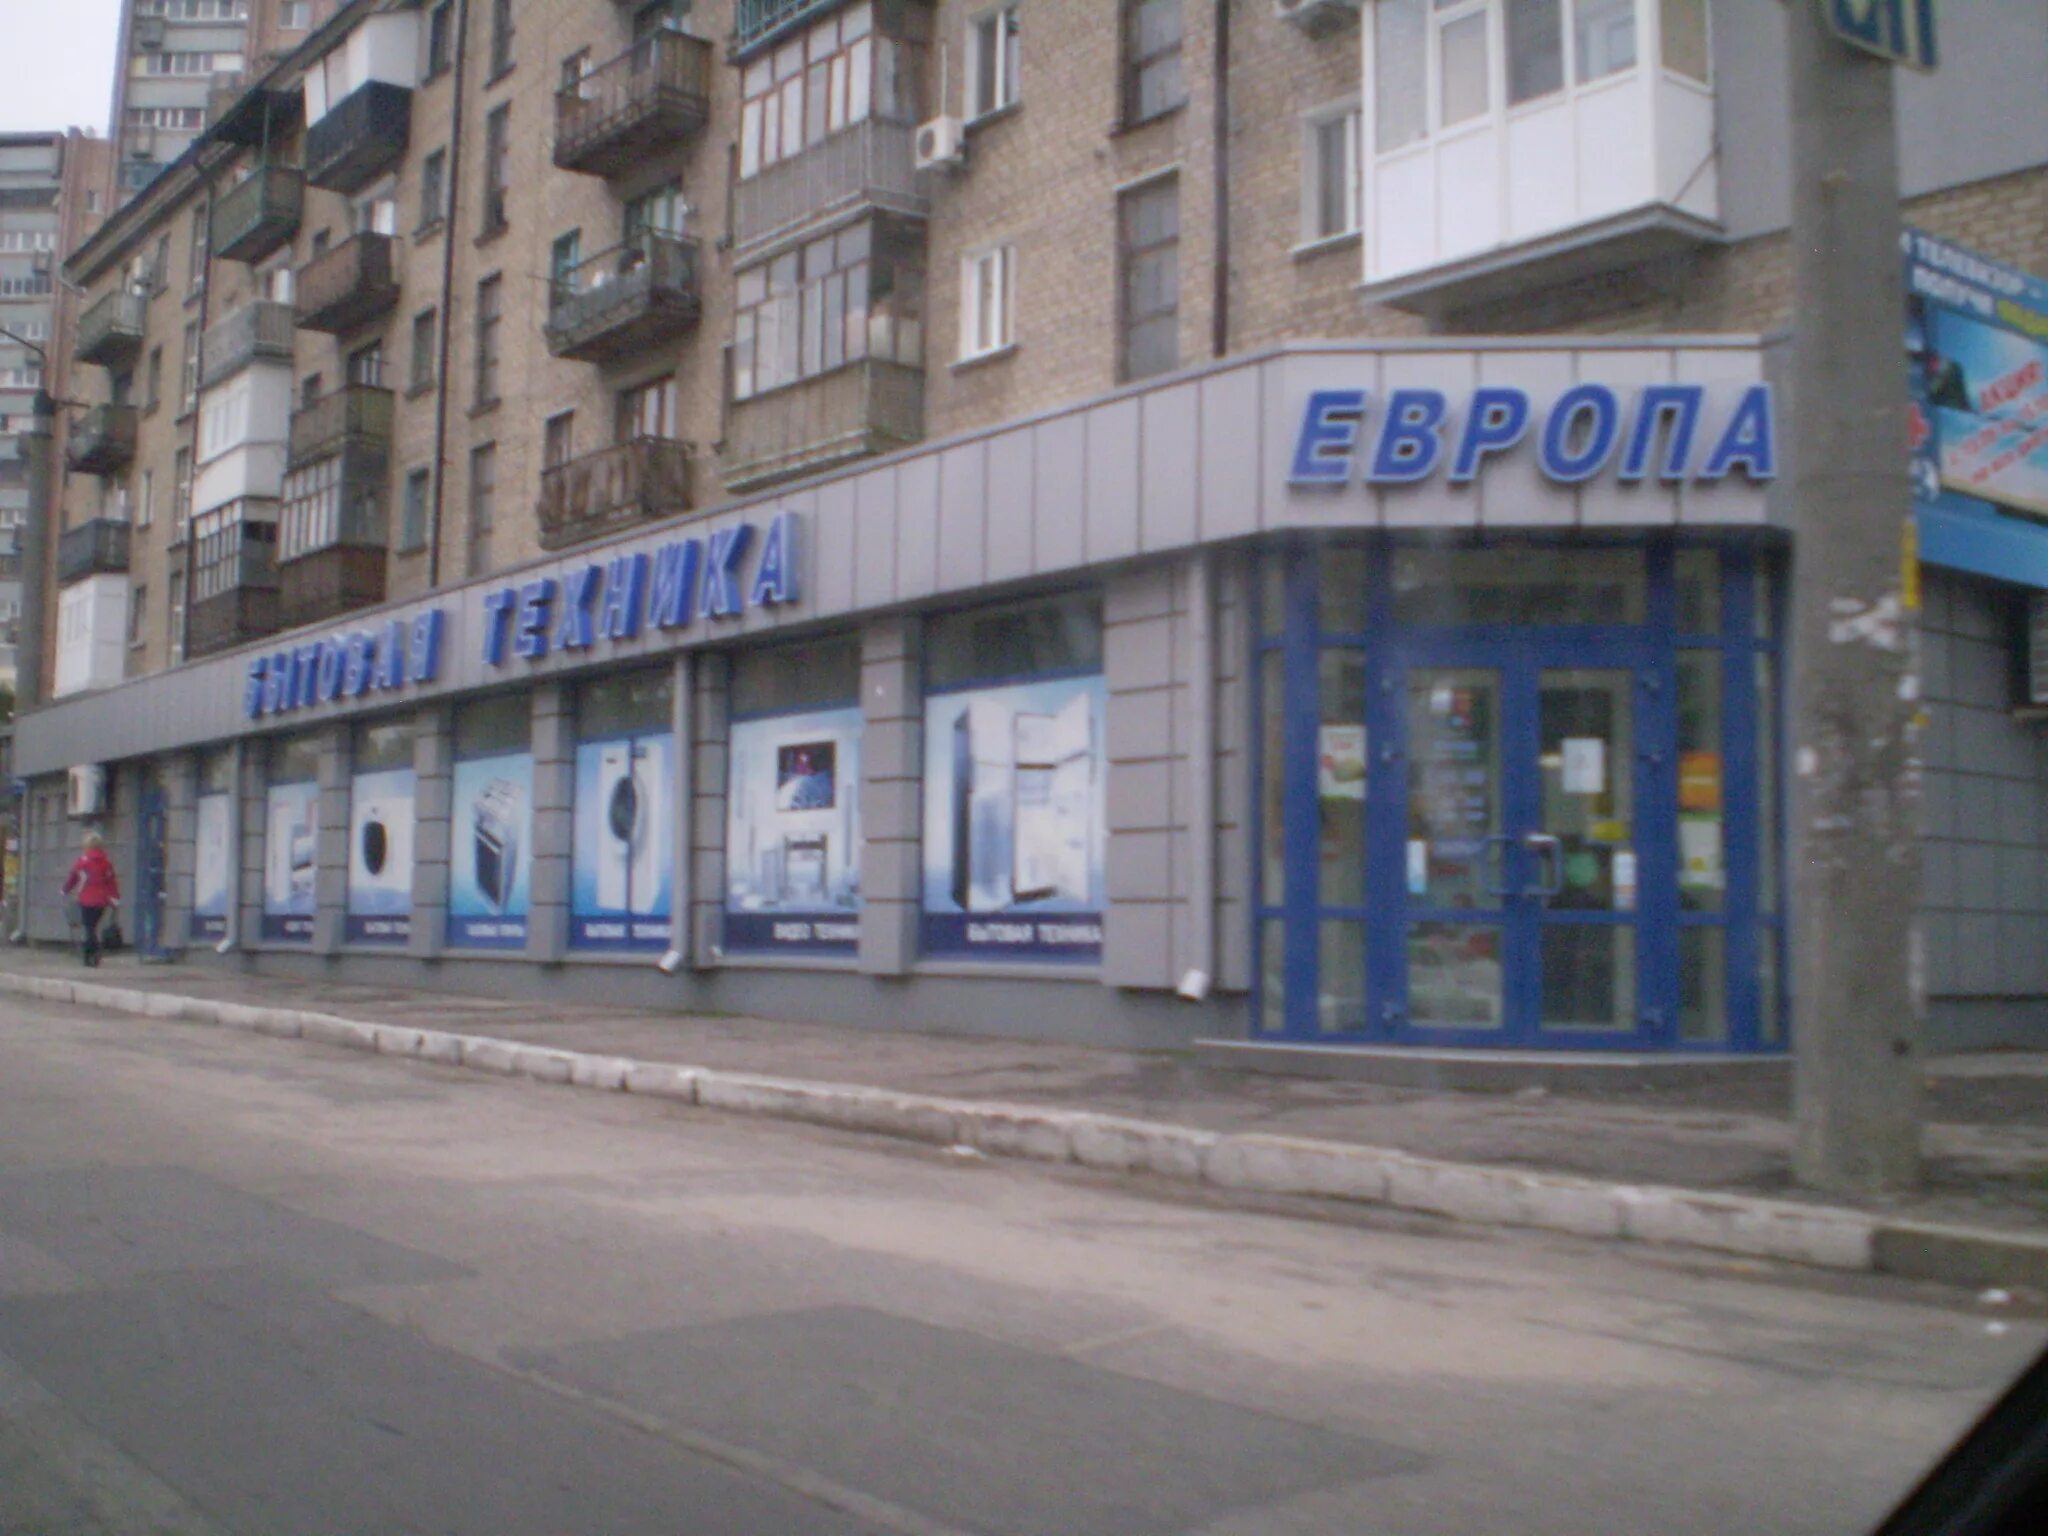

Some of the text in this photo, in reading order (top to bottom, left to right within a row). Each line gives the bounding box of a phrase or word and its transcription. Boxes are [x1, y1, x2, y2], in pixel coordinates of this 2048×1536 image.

[1287, 382, 1777, 485] ЕВРОПА
[244, 511, 800, 719] БЫТОВАЯ ТЕХНИКА
